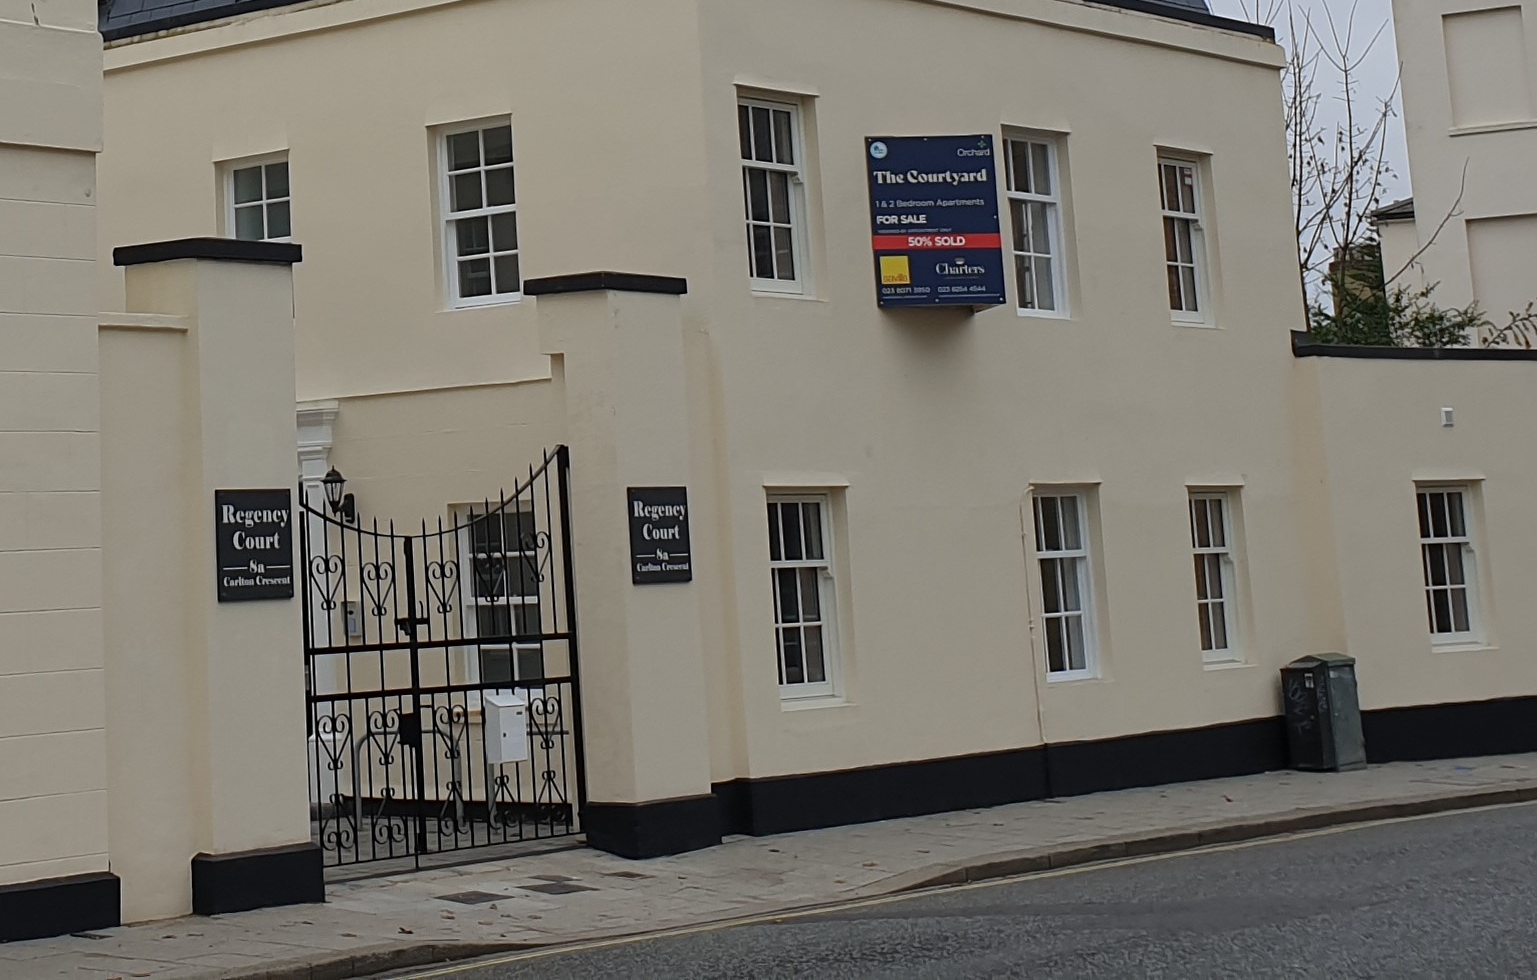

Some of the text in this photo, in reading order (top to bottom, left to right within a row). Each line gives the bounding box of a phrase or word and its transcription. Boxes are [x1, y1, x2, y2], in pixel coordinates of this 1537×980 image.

[957, 148, 990, 157] Orchard
[873, 169, 987, 186] The Courtyard
[881, 200, 888, 208] &
[896, 199, 935, 208] Bedroom
[936, 198, 985, 208] Apartments
[876, 214, 927, 225] FOR SALE
[908, 236, 966, 247] 50% SOLD
[935, 262, 985, 275] Charters
[222, 504, 289, 528] Regency
[634, 500, 685, 521] Regency
[643, 523, 679, 540] Court
[233, 530, 280, 550] Court
[656, 548, 669, 561] 8a
[249, 559, 265, 574] 8a
[223, 575, 291, 587] Carlton Crescent
